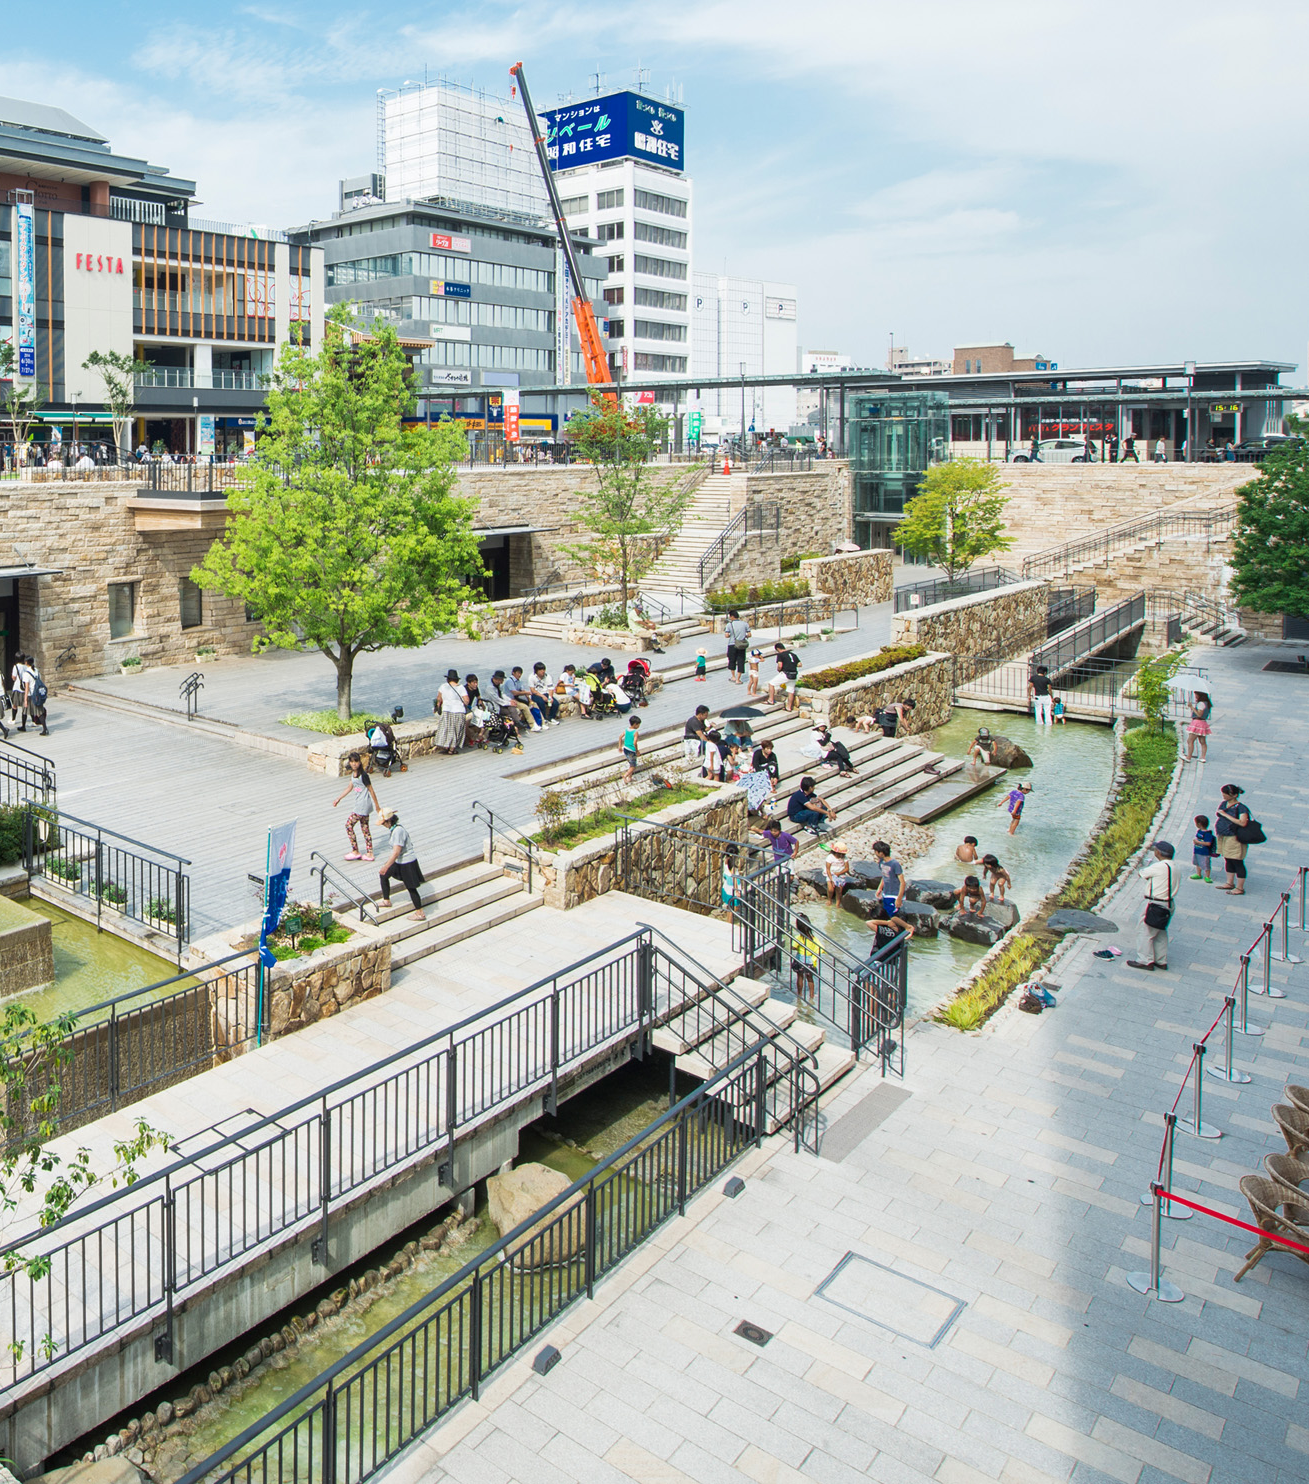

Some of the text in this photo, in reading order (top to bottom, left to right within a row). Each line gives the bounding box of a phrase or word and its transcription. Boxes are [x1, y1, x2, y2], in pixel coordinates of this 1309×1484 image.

[554, 105, 600, 122] マンションは
[547, 134, 611, 160] 昭和住宅
[76, 252, 124, 275] FESTA
[696, 298, 703, 308] P
[743, 302, 748, 312] P
[778, 304, 784, 314] P
